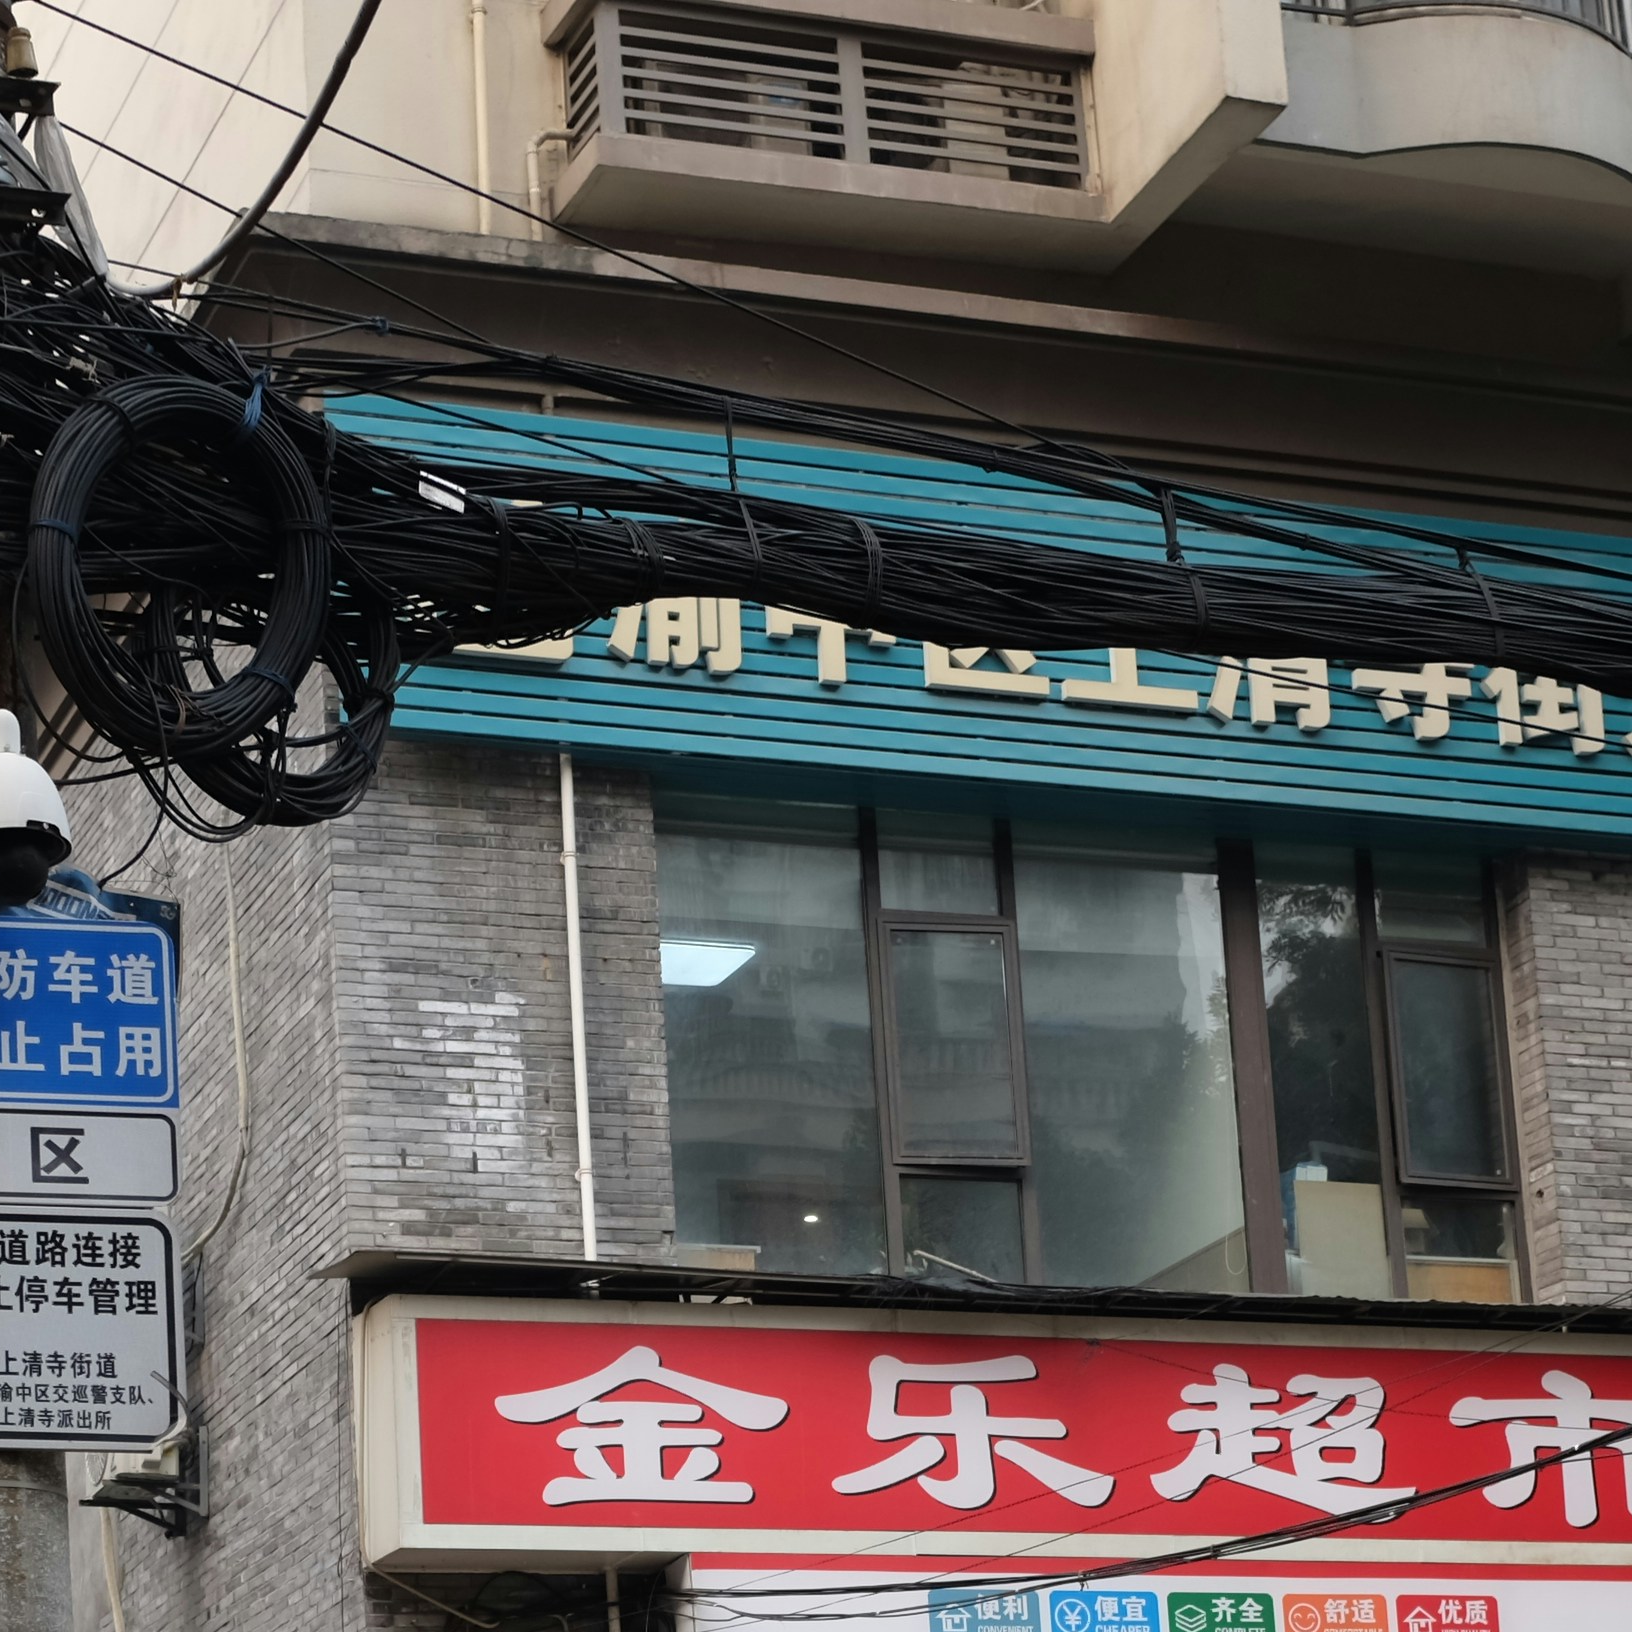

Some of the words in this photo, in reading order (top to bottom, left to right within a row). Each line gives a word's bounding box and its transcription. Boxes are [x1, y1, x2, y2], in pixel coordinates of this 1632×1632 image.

[973, 1594, 1029, 1622] 便利
[1093, 1594, 1150, 1623] 便宜
[1210, 1596, 1266, 1625] 齐全
[1323, 1597, 1378, 1626] 舒适
[1437, 1598, 1489, 1627] 优质
